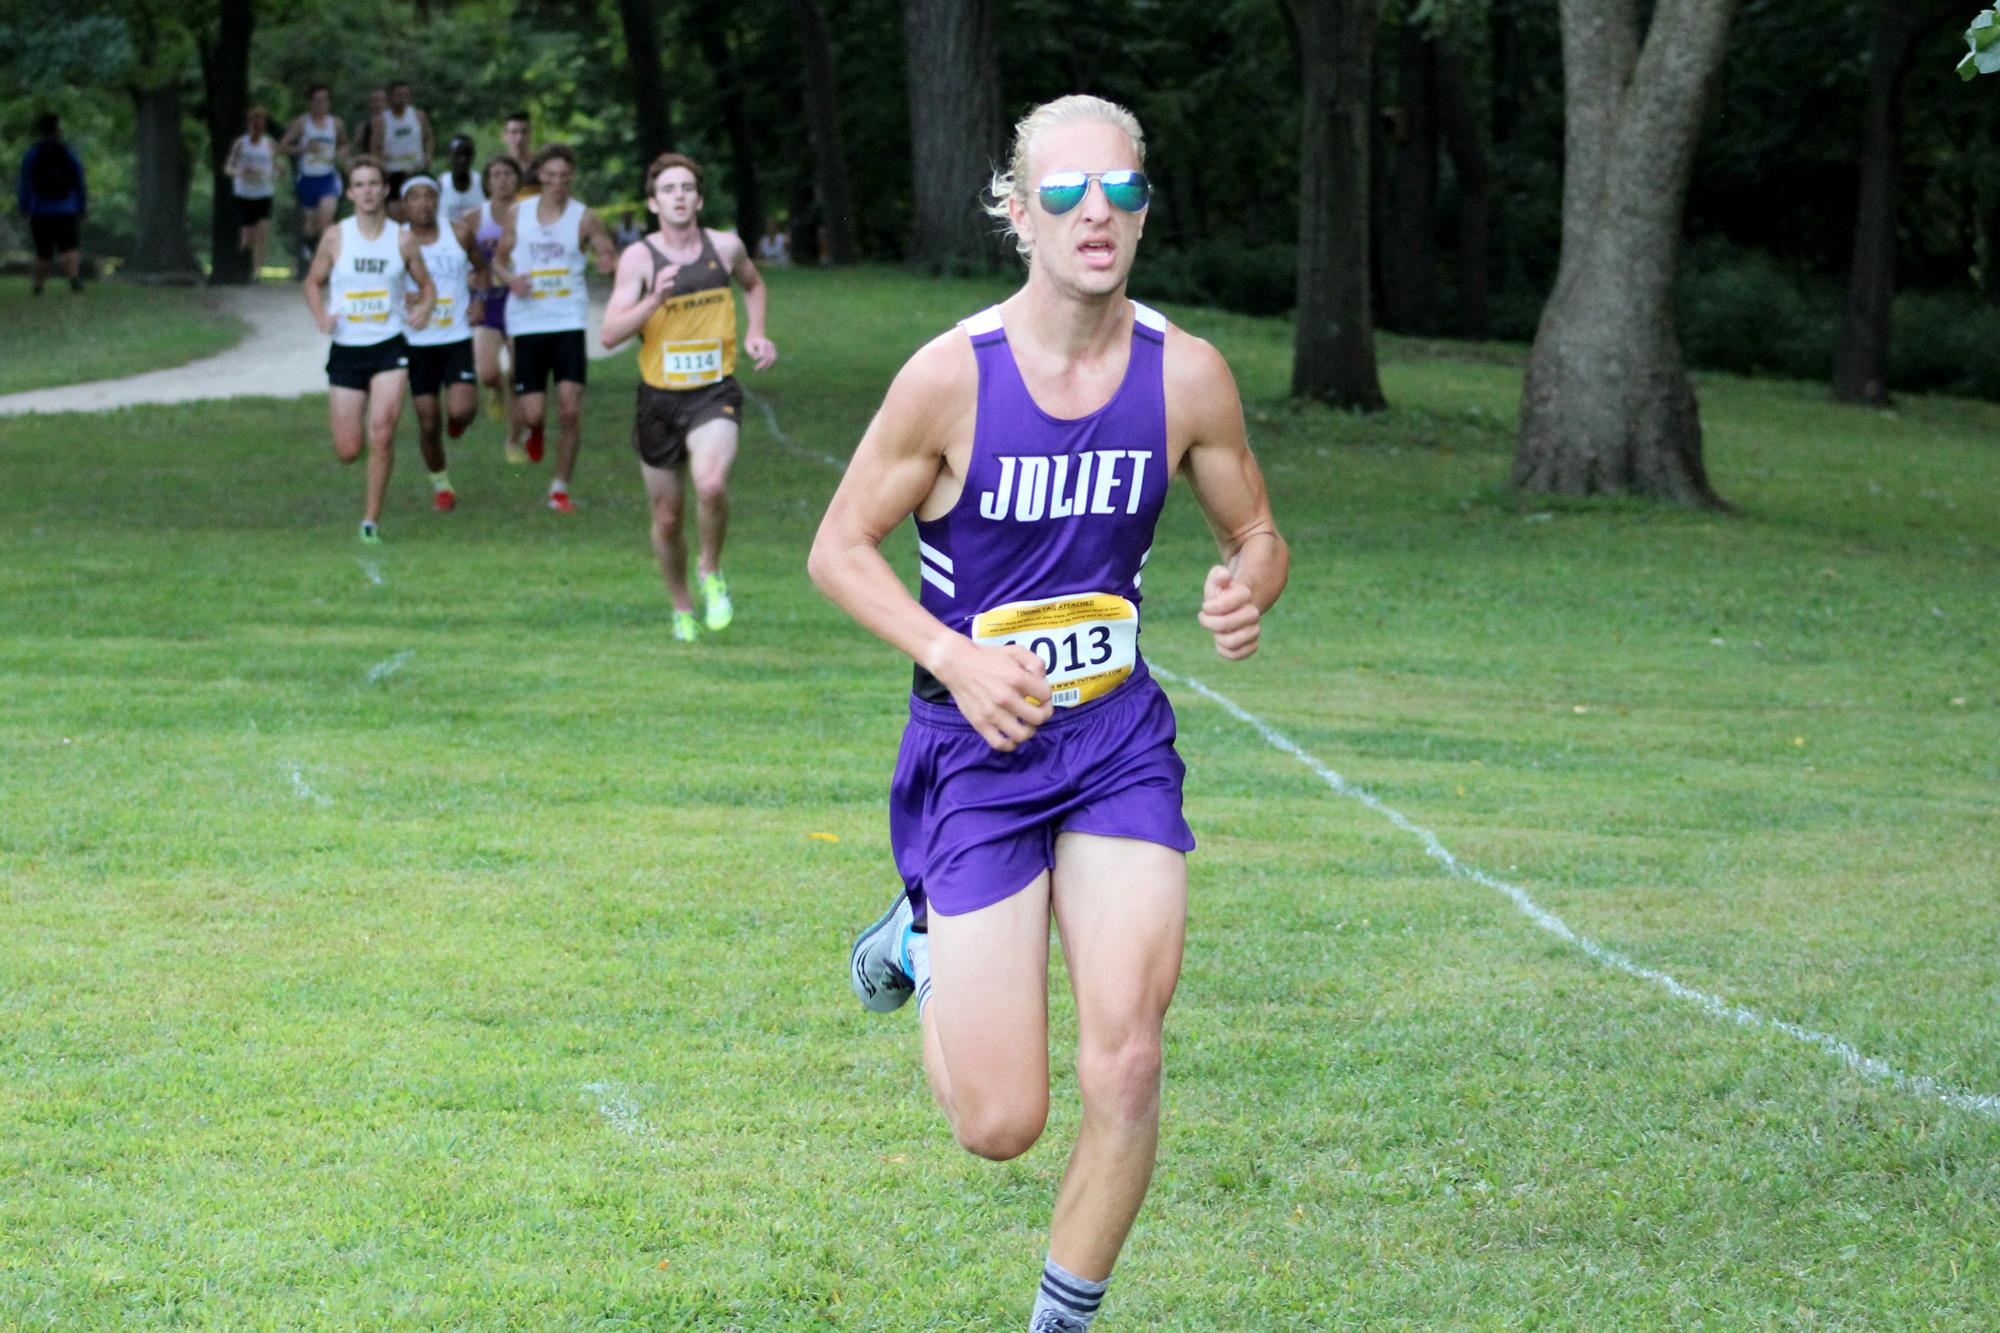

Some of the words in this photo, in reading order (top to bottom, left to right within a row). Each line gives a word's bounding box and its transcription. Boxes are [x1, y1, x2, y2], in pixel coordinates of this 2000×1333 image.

[674, 355, 714, 370] 1114
[980, 450, 1153, 522] JOLIET
[1057, 600, 1095, 609] ATTACHED
[1004, 626, 1113, 676] 013
